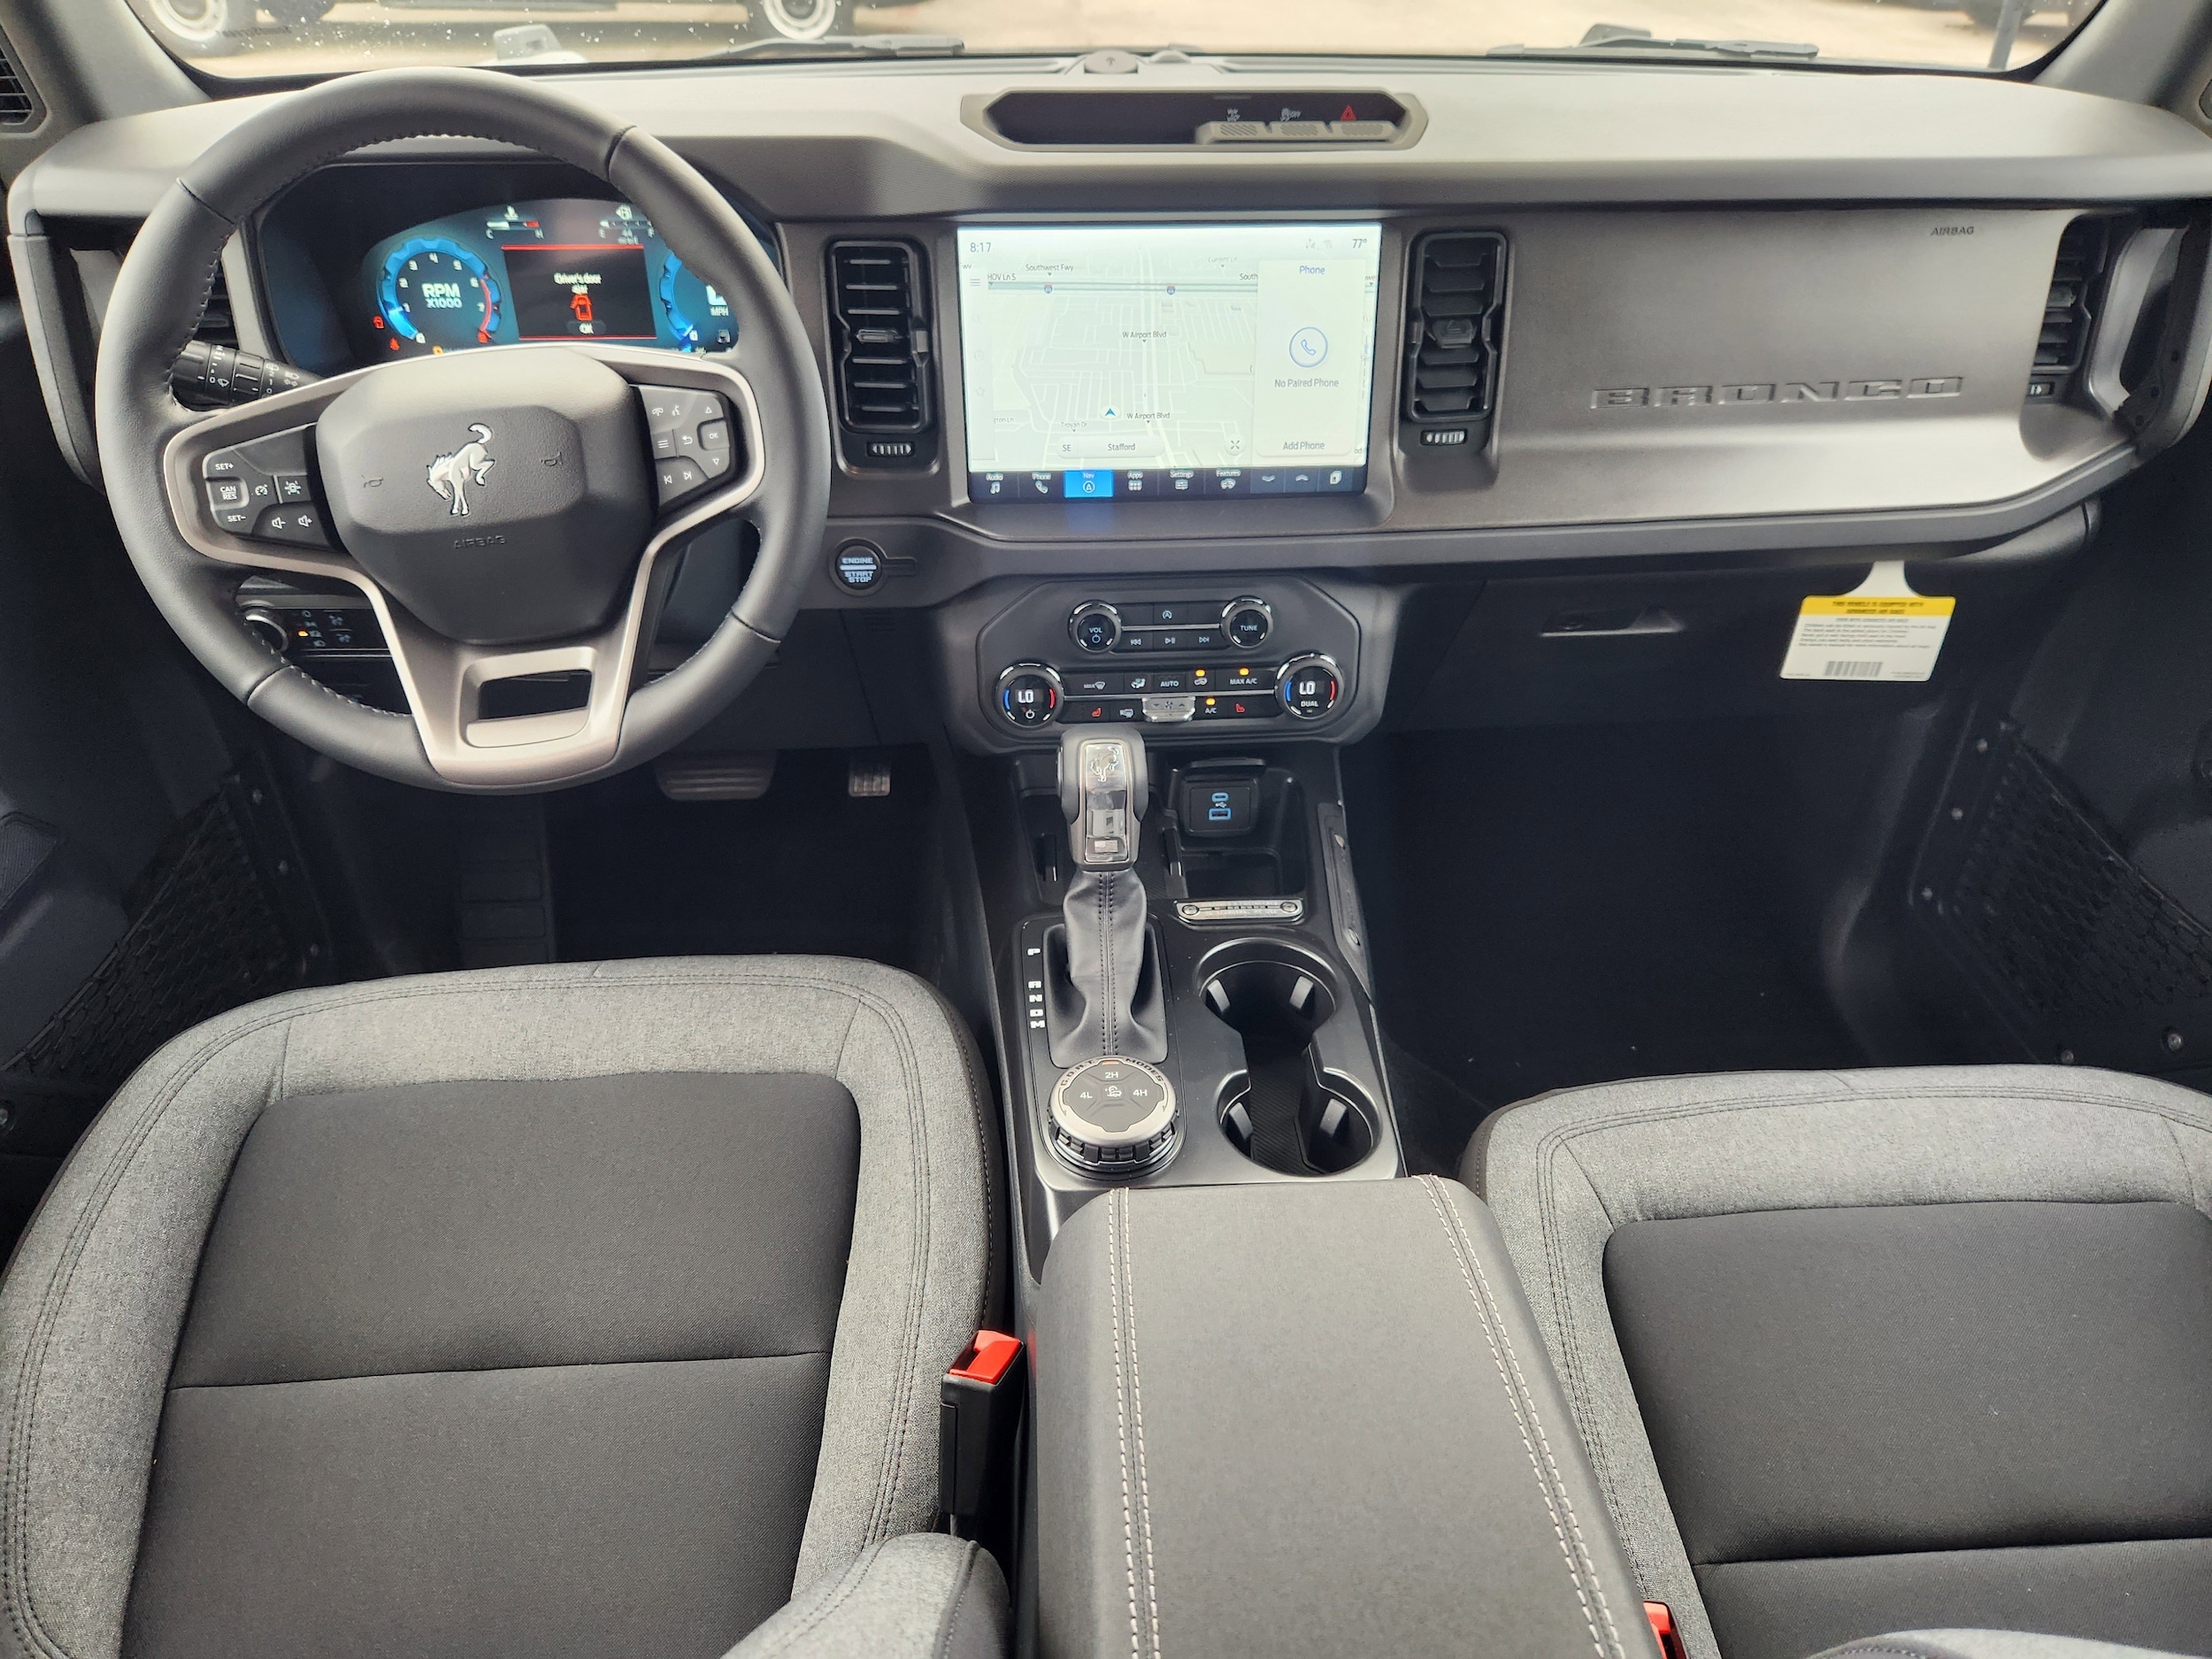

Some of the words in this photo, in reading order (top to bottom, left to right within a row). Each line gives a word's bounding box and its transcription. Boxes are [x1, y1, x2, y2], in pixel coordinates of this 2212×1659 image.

[1930, 227, 1974, 236] AIRBAG
[970, 242, 992, 253] 8:17
[1061, 264, 1074, 273] Fwy
[1299, 265, 1325, 275] Phone
[421, 283, 461, 298] RPM
[1274, 379, 1286, 388] No
[1287, 378, 1313, 388] Paired
[1314, 378, 1340, 388] Phone
[1591, 376, 1964, 410] BRONCO
[1108, 443, 1136, 452] Stafford
[1283, 442, 1299, 450] Add
[986, 472, 1004, 481] Audio
[1127, 471, 1143, 480] Apps
[1170, 470, 1194, 479] Settings
[1216, 469, 1240, 478] Features
[1299, 680, 1317, 695] LO
[1018, 688, 1034, 703] LO
[1029, 994, 1043, 1002] N
[1125, 1057, 1165, 1082] MODES
